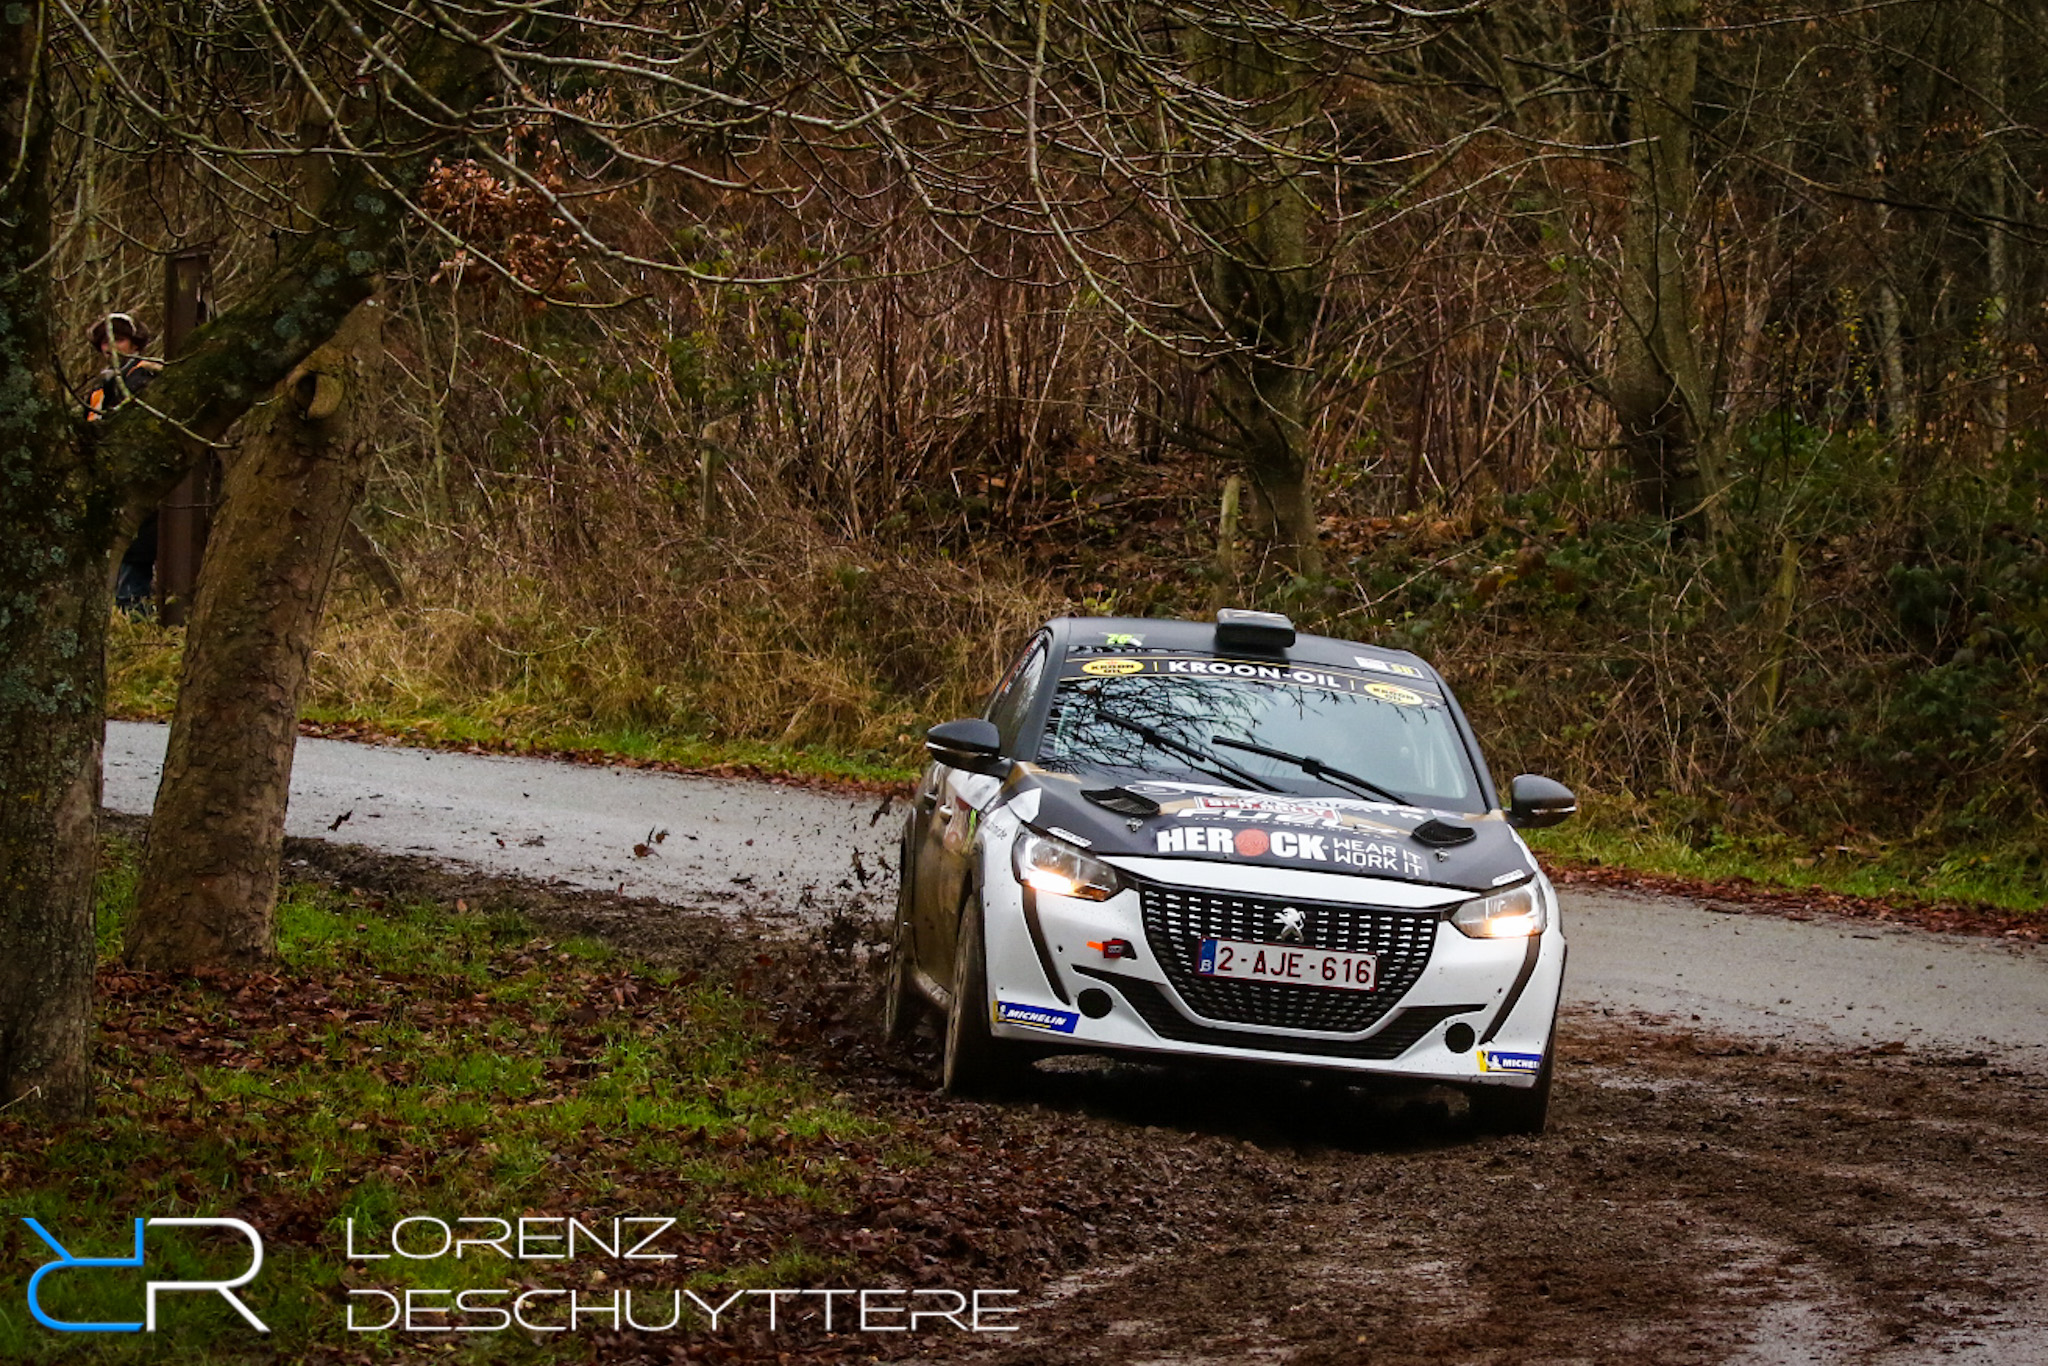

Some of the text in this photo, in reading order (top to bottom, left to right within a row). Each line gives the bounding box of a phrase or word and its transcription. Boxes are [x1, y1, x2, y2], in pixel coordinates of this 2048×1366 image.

[1168, 661, 1342, 688] KROON-OIL
[1333, 838, 1422, 864] WEAR IT
[1333, 851, 1424, 877] WORK IT
[1200, 959, 1213, 973] B
[1217, 946, 1371, 984] 2-AJE-616
[1006, 1009, 1067, 1026] MICHELIN
